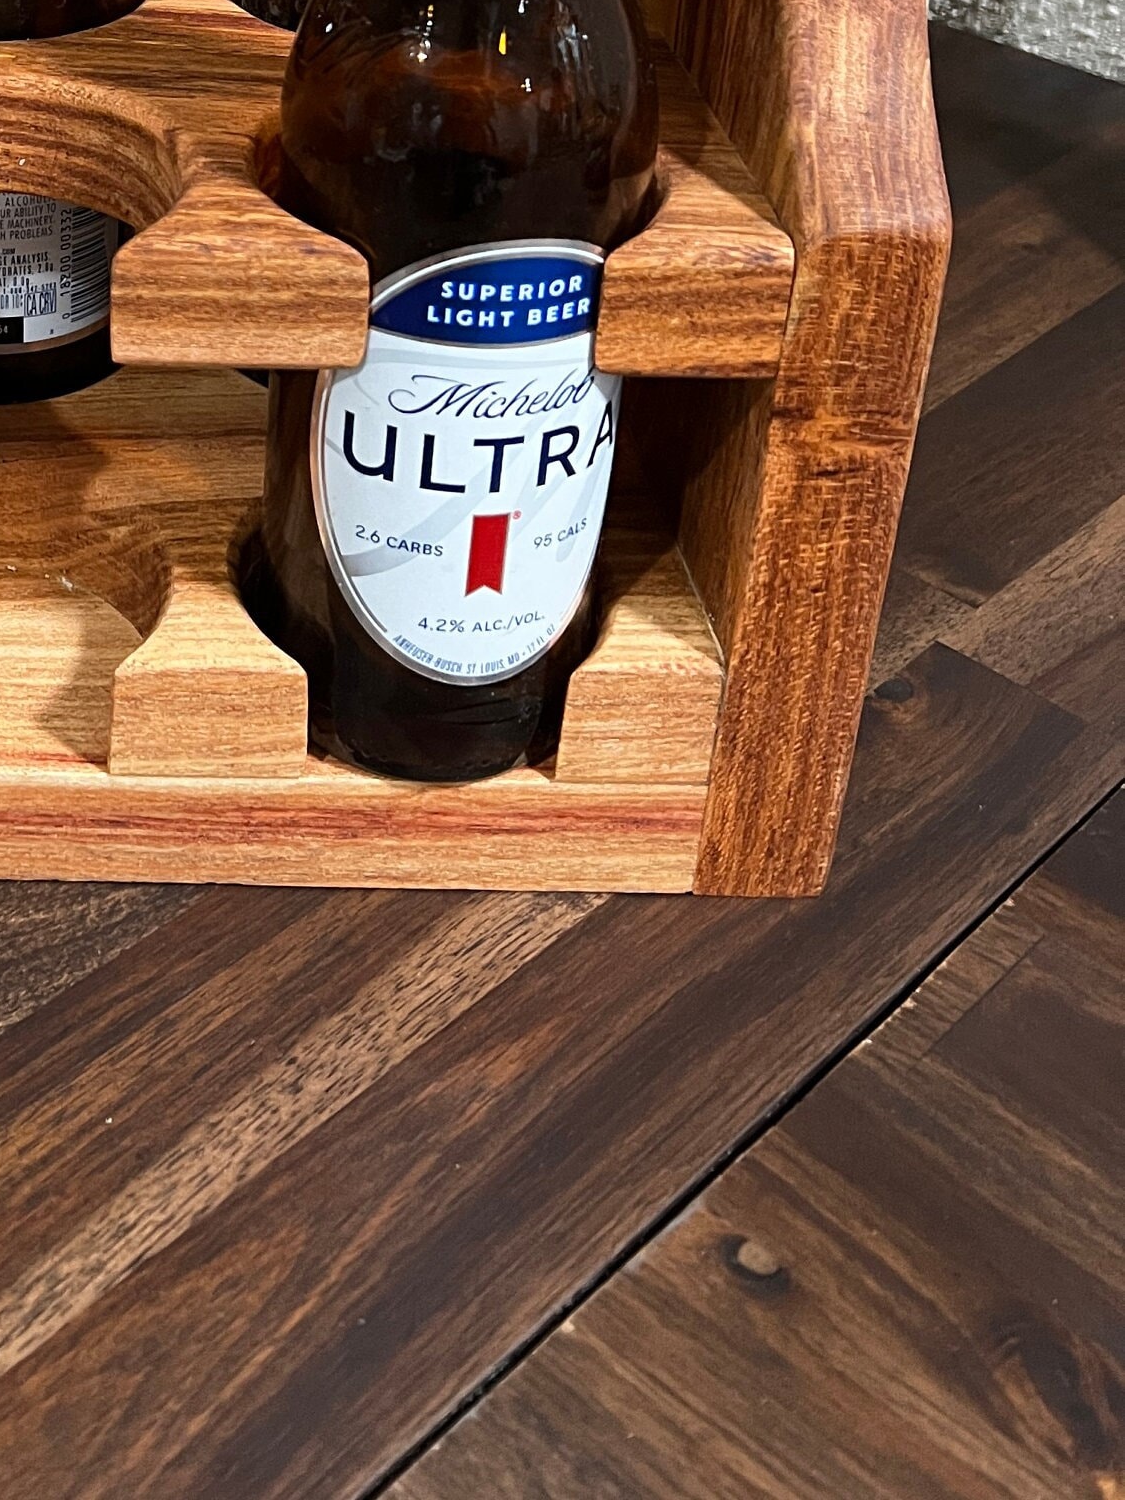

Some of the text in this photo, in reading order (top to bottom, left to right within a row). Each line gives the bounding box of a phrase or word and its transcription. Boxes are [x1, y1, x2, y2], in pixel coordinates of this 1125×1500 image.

[14, 205, 43, 217] ABILITY
[47, 202, 56, 213] TO
[27, 291, 54, 316] CA CRV
[440, 274, 583, 303] SUPERIOR
[427, 297, 591, 328] LIGHT BEER
[388, 368, 596, 420] Michelob
[342, 399, 613, 494] ULTRA
[355, 524, 444, 558] 2.6 CARBS
[533, 517, 587, 549] 95 CALS
[417, 617, 465, 633] 4.2%
